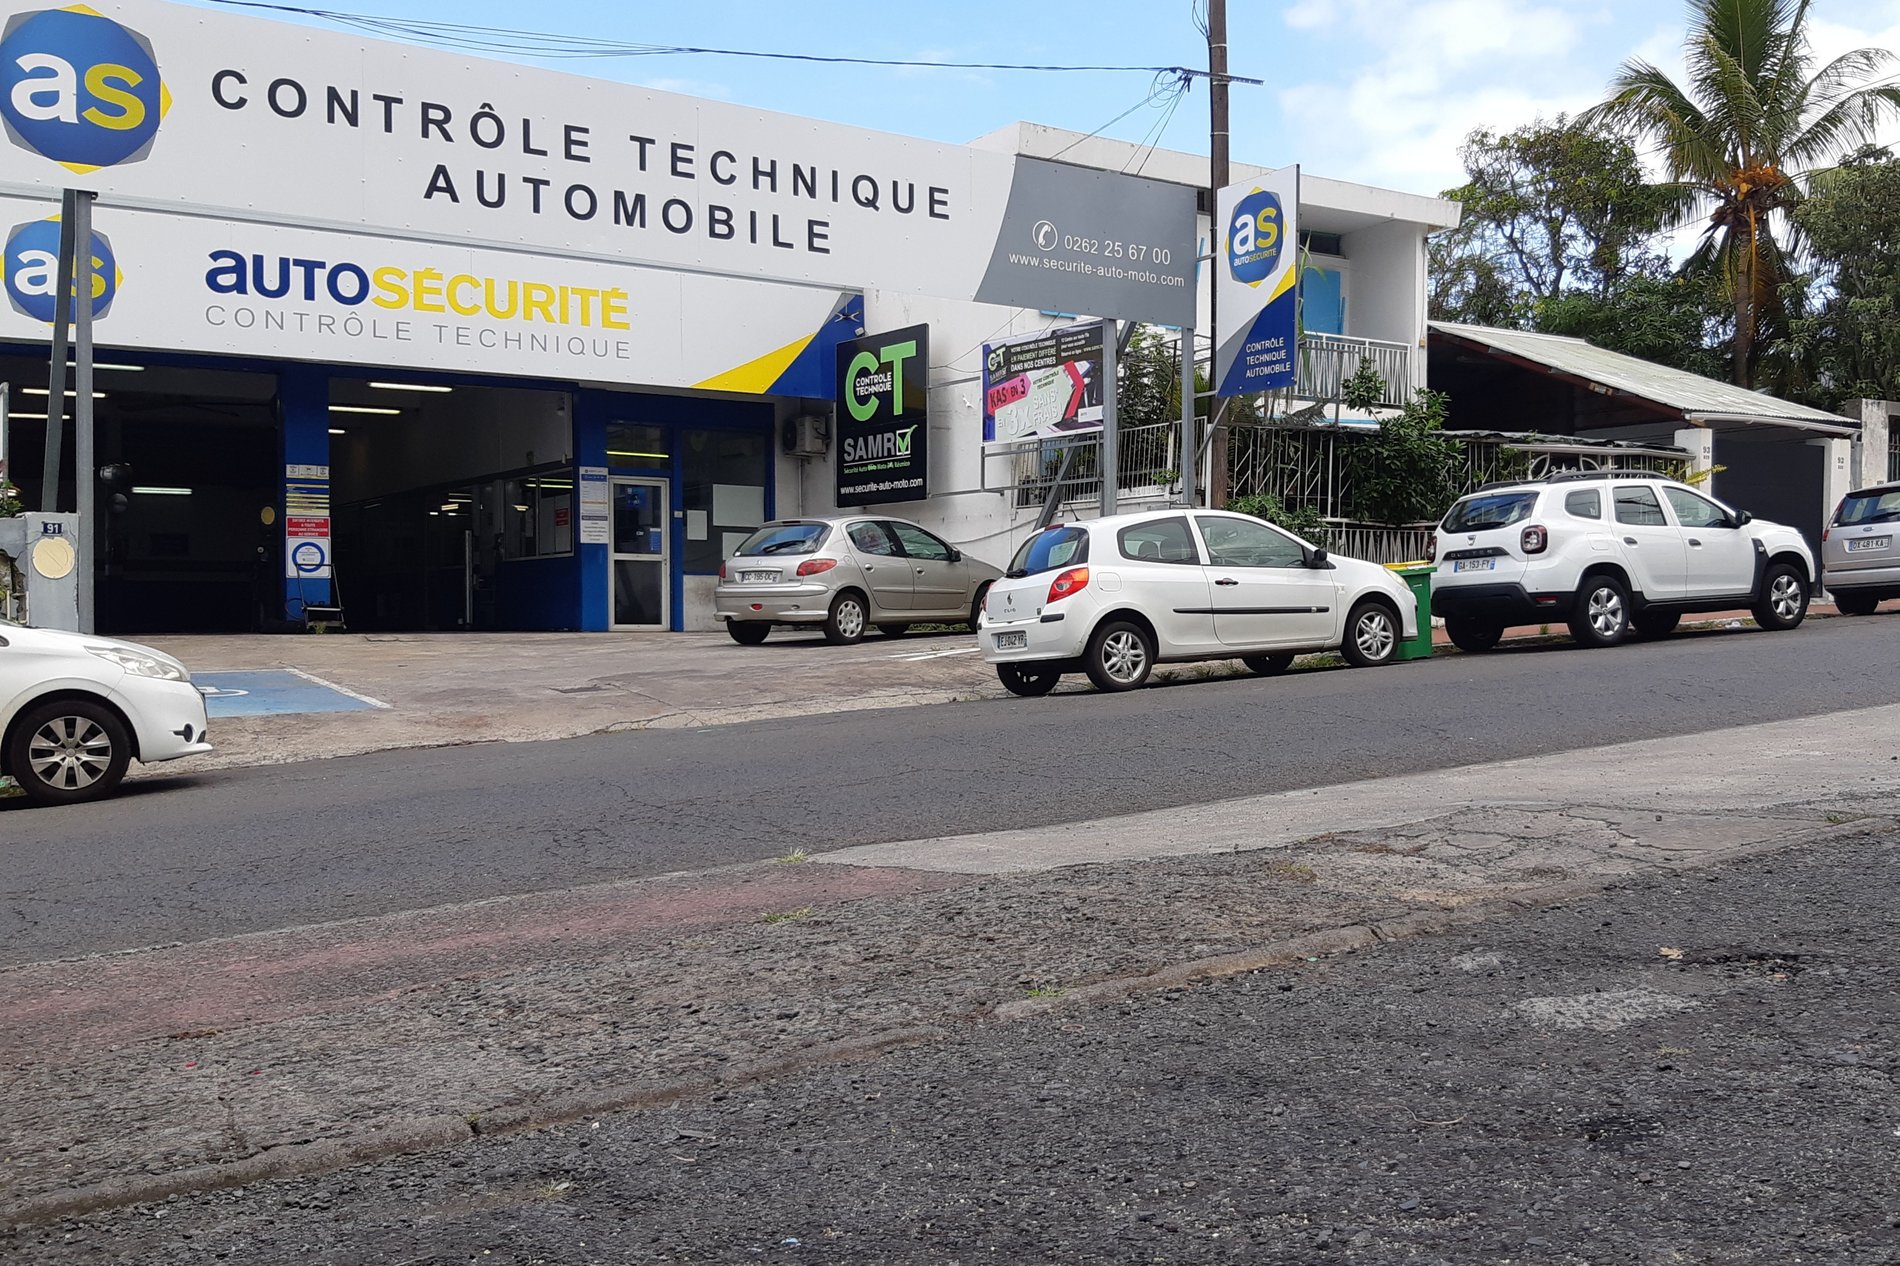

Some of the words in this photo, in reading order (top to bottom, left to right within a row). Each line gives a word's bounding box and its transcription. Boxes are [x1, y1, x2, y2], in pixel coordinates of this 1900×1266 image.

[11, 52, 146, 131] as
[211, 68, 592, 164] CONTRÔLE
[629, 134, 951, 221] TECHNIQUE
[423, 163, 831, 255] AUTOMOBILE
[1233, 207, 1278, 255] as
[1064, 234, 1099, 255] 0262
[1104, 240, 1123, 258] 25
[1128, 244, 1147, 262] 67
[1152, 247, 1171, 265] 00
[1008, 253, 1185, 287] www.securite-auto-moto.com
[205, 304, 412, 342] CONTRÔLE
[432, 324, 631, 360] TECHNIQUE
[1245, 337, 1284, 353] CONTRÔLE
[1010, 361, 1023, 373] DANS
[1024, 359, 1034, 370] NOS
[1034, 356, 1057, 368] CENTRES
[1246, 349, 1287, 366] TECHNIQUE
[855, 372, 892, 387] CONTROLE
[1245, 363, 1291, 378] AUTOMOBILE
[845, 340, 917, 422] CT
[855, 382, 892, 397] TECHNIQUE
[1019, 378, 1026, 395] 3
[840, 477, 924, 495] www.securite-auto-moto.com
[47, 523, 59, 534] 91
